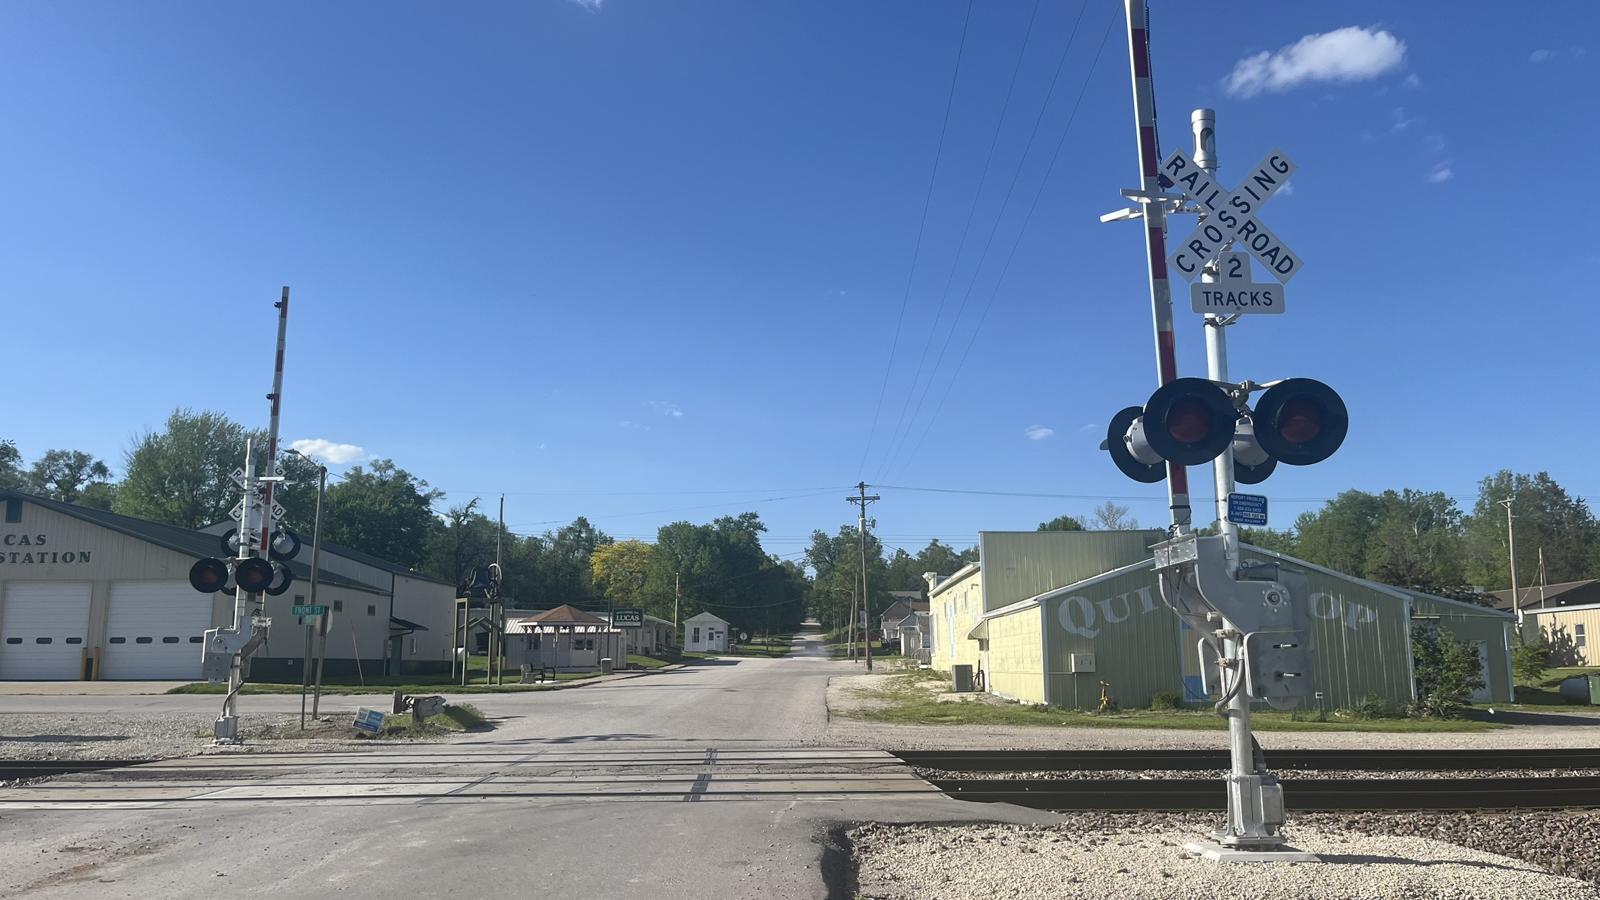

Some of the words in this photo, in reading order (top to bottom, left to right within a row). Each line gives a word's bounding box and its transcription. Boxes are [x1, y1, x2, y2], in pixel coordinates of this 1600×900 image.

[1175, 155, 1289, 273] CROSSING
[1228, 257, 1243, 278] 2
[1202, 291, 1273, 307] TRACKS
[1058, 585, 1161, 640] QUI
